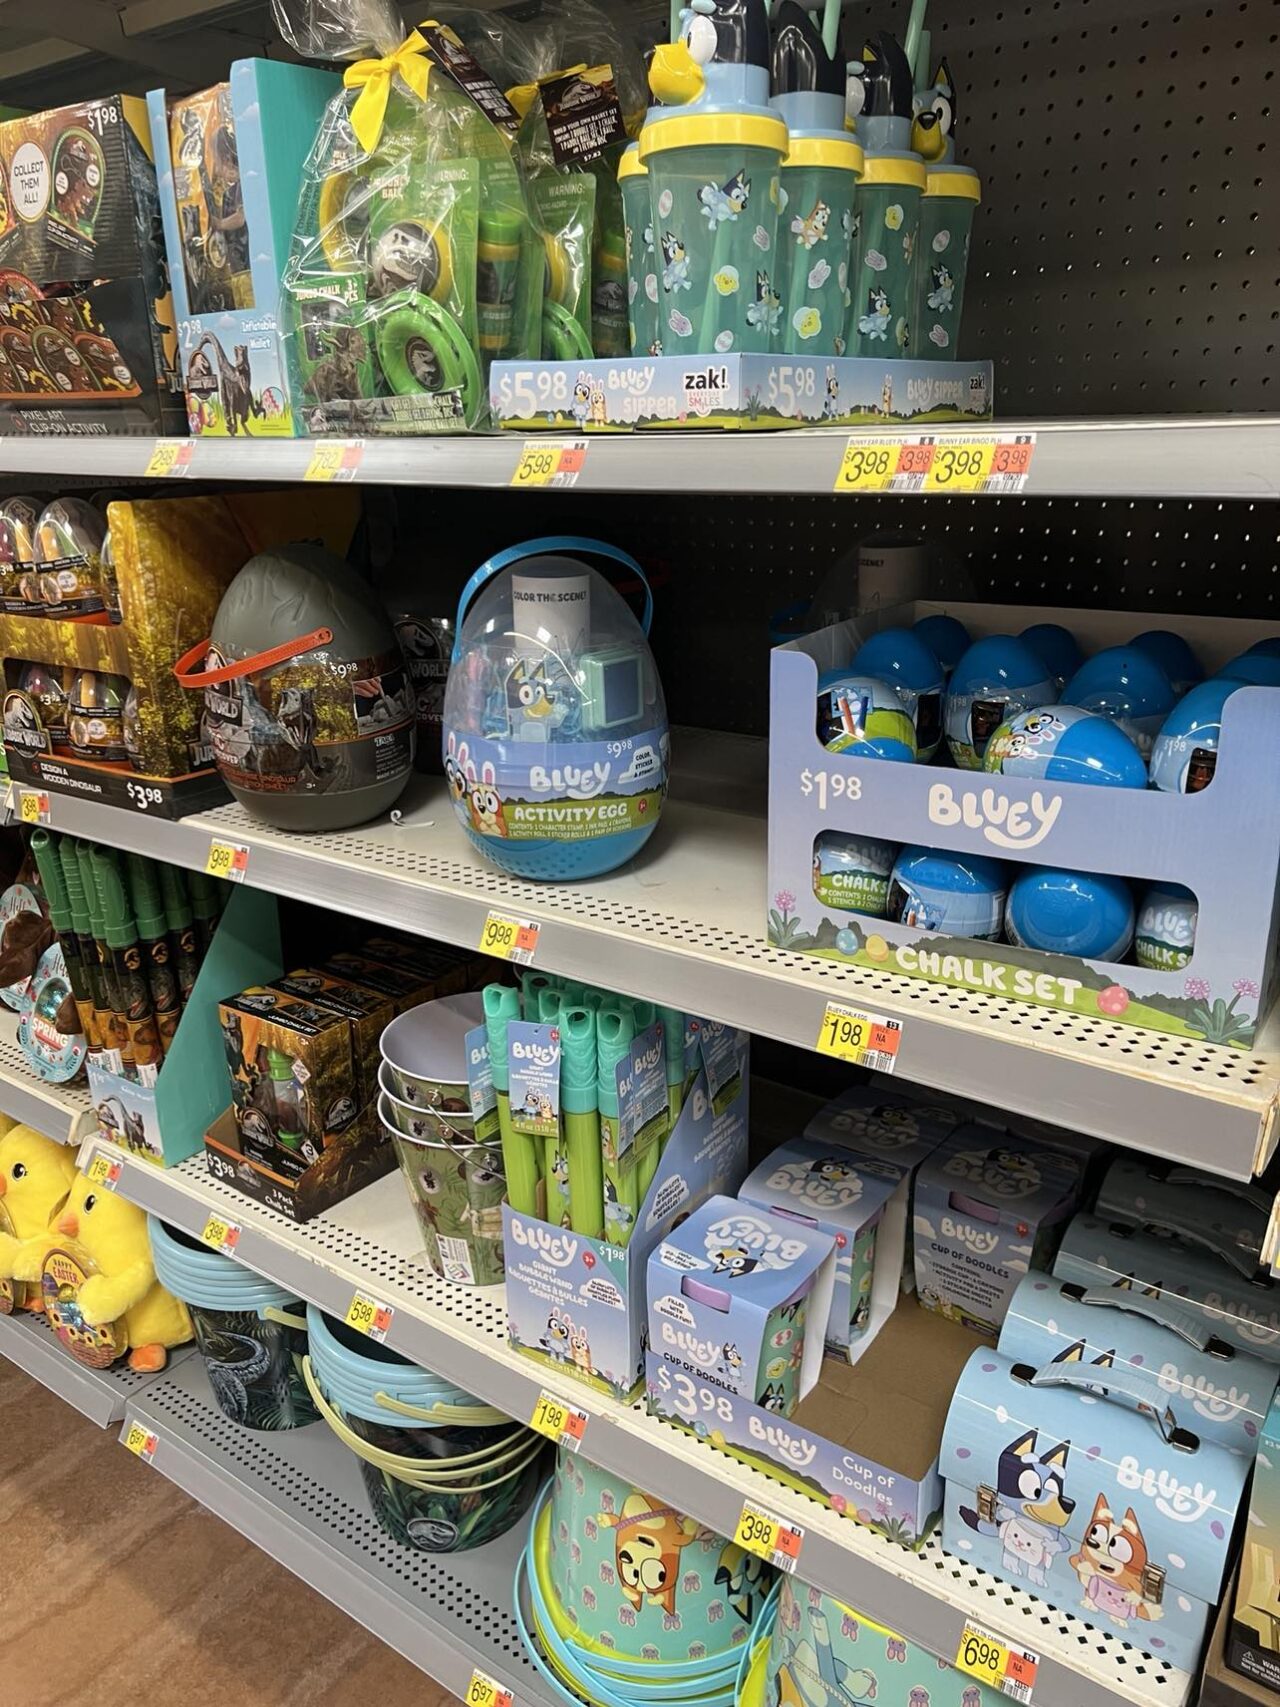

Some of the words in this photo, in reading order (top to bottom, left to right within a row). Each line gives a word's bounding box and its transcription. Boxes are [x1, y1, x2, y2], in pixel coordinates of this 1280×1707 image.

[14, 161, 44, 177] COLLECT
[20, 177, 40, 189] THEM
[500, 371, 567, 419] $598
[685, 368, 726, 390] zak!
[768, 367, 815, 417] $598
[49, 410, 65, 420] ART
[127, 781, 162, 809] $398
[530, 761, 611, 800] BLUEY
[800, 768, 862, 810] $198
[514, 806, 596, 822] ACTIVITY
[598, 803, 628, 819] EGG
[928, 783, 1062, 850] BLUEY
[832, 873, 880, 893] CHALK
[895, 945, 1007, 992] CHALK
[1010, 968, 1083, 1006] SET
[32, 1016, 68, 1047] SPRING
[824, 1015, 863, 1047] $198
[512, 1041, 559, 1067] BLUEY
[208, 1153, 235, 1178] $398
[766, 1171, 863, 1211] BLUEY
[511, 1218, 578, 1268] BLUEY
[941, 1217, 999, 1254] BLUEY
[600, 1246, 625, 1263] $198
[931, 1242, 950, 1255] CUP
[952, 1250, 964, 1260] OF
[966, 1256, 1009, 1279] DOODLES
[661, 1322, 720, 1367] BLUEY
[663, 1352, 682, 1367] CUP
[683, 1362, 696, 1374] OF
[695, 1368, 739, 1395] DOODLES
[1157, 1362, 1249, 1422] BLUEY
[657, 1364, 735, 1423] $398
[748, 1416, 817, 1466] BLUEY
[832, 1466, 893, 1507] Doodles
[842, 1454, 871, 1480] Cup
[874, 1473, 895, 1490] of
[1116, 1455, 1216, 1523] BLUEY
[961, 1633, 1000, 1671] $698
[1012, 1662, 1023, 1673] NA
